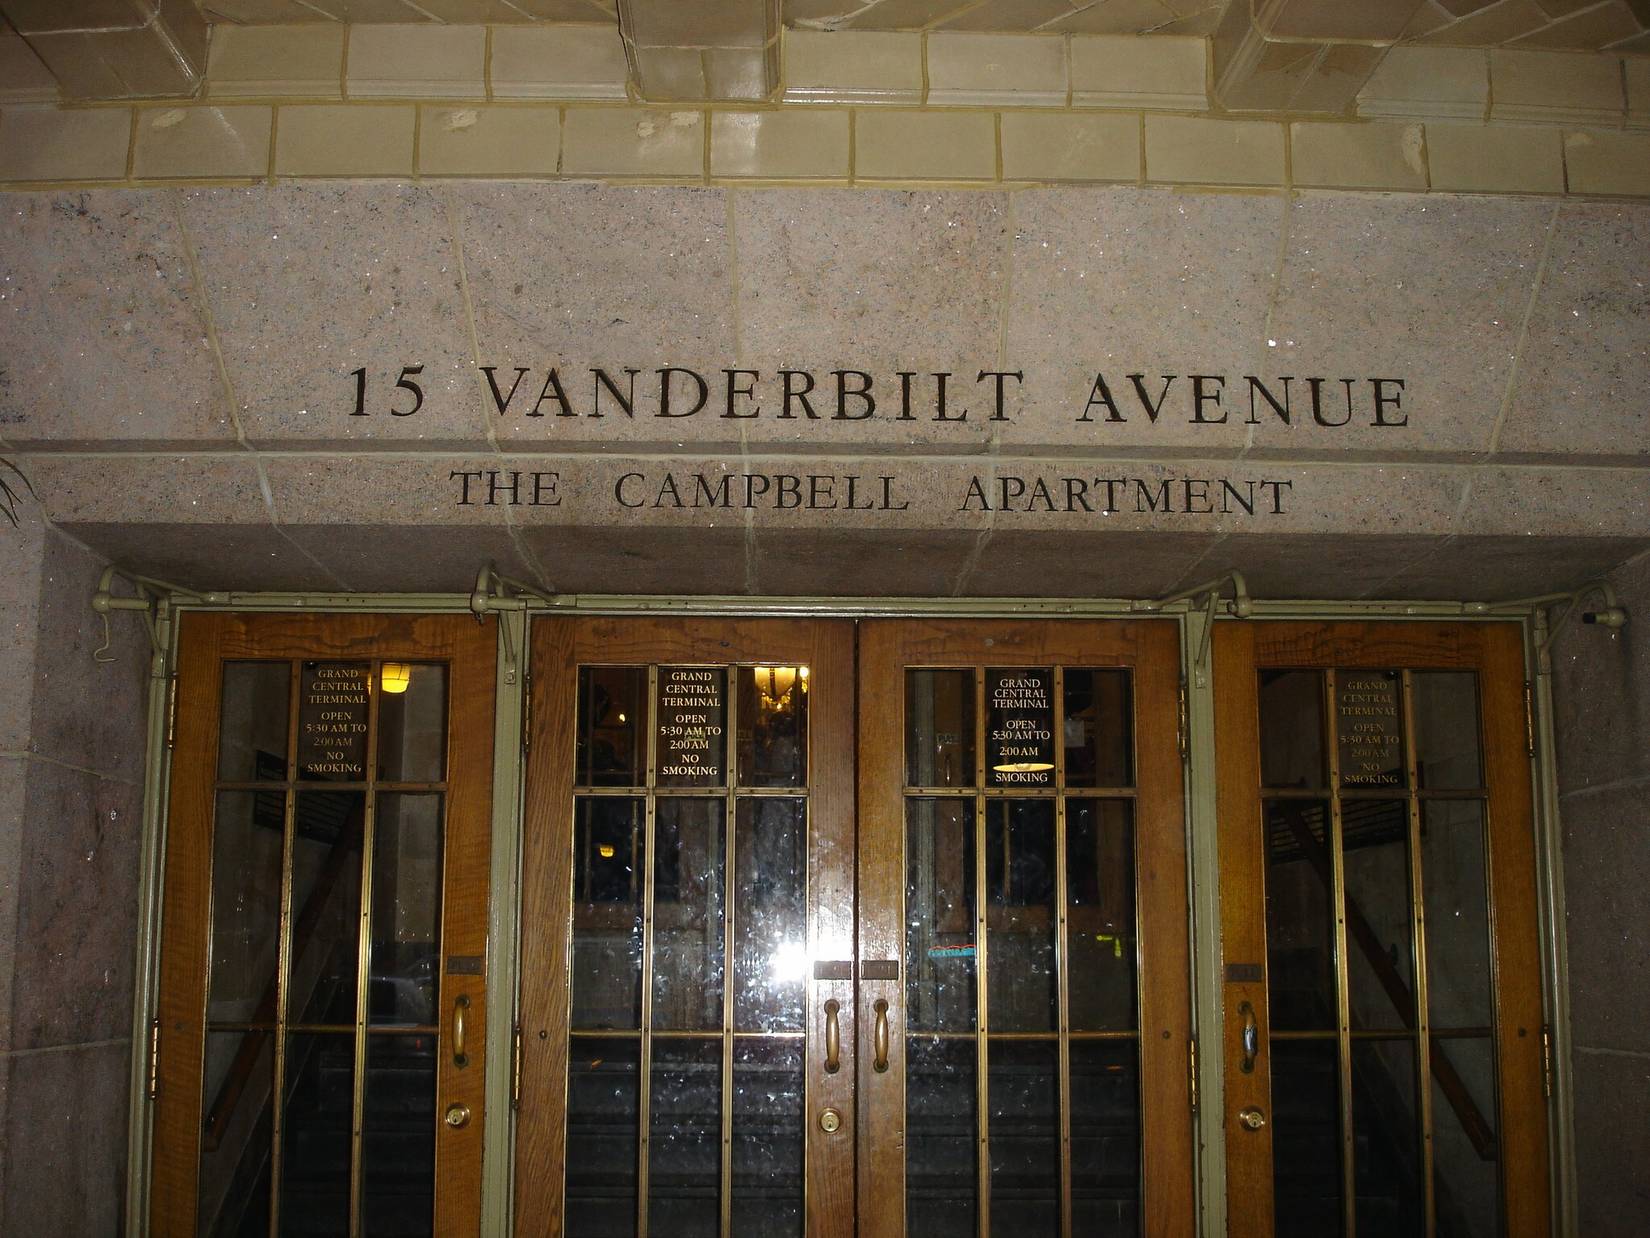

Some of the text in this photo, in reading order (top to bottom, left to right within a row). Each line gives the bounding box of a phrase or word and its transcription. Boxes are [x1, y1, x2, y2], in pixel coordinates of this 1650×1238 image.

[349, 364, 1409, 426] 15 VANDERBILT AVENUE
[449, 470, 1293, 515] THE CAMPBELL APARTMENT
[318, 669, 359, 678] GRAND
[671, 672, 712, 681] GRAND
[312, 682, 364, 691] CENTRAL
[1000, 679, 1040, 688] GRAND
[1347, 681, 1387, 690] GRAND
[666, 685, 717, 694] CENTRAL
[994, 689, 1046, 698] CENTRAL
[309, 695, 367, 704] TERMINAL
[662, 698, 720, 706] TERMINAL
[1343, 695, 1392, 703] CENTRAL
[993, 699, 1049, 709] TERMINAL
[1341, 707, 1397, 715] TERMINAL
[321, 712, 352, 720] OPEN
[675, 714, 707, 723] OPEN
[330, 724, 347, 732] AM
[350, 724, 367, 733] TO
[1006, 720, 1036, 729] OPEN
[1354, 723, 1384, 732] OPEN
[660, 726, 721, 736] 5:30 AM TO
[992, 731, 1051, 740] 5:30 AM TO
[335, 738, 352, 746] AM
[670, 740, 709, 749] 2:00 AM
[1383, 736, 1400, 744] TO
[326, 751, 344, 760] NO
[1000, 747, 1039, 756] 2:00 AM
[681, 754, 699, 763] NO
[307, 764, 361, 773] SMOKING
[662, 766, 718, 776] SMOKING
[1362, 763, 1380, 771] NO
[996, 773, 1048, 782] SMOKING
[1344, 775, 1398, 784] SMOKING
